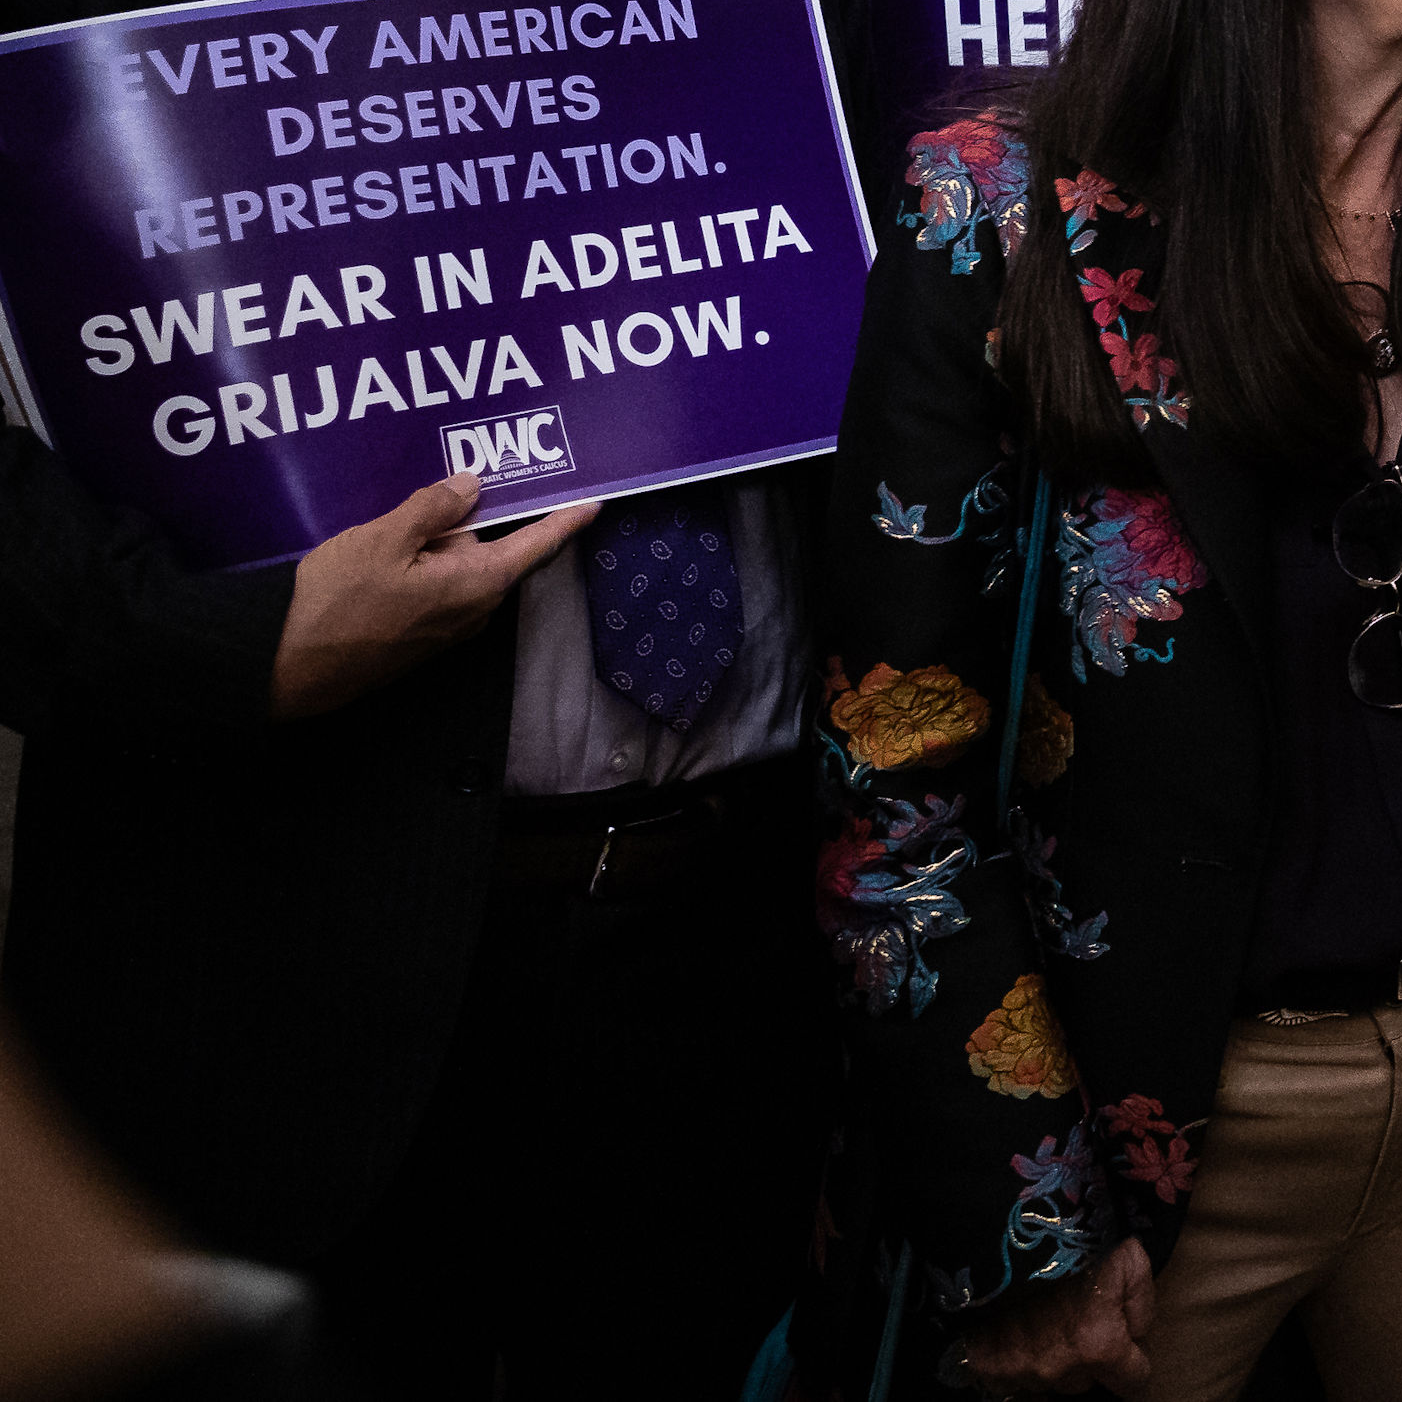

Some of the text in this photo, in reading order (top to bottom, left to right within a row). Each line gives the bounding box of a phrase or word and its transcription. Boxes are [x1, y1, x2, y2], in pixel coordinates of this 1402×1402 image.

[104, 25, 343, 103] EVERY
[267, 74, 601, 156] DESERVES
[134, 131, 728, 259] REPRESENTATION.
[81, 204, 814, 378] SWEAR IN ADELITA
[152, 296, 770, 457] GRIJALVA NOW.
[447, 412, 564, 475] DWC
[540, 459, 568, 471] CAUCUS
